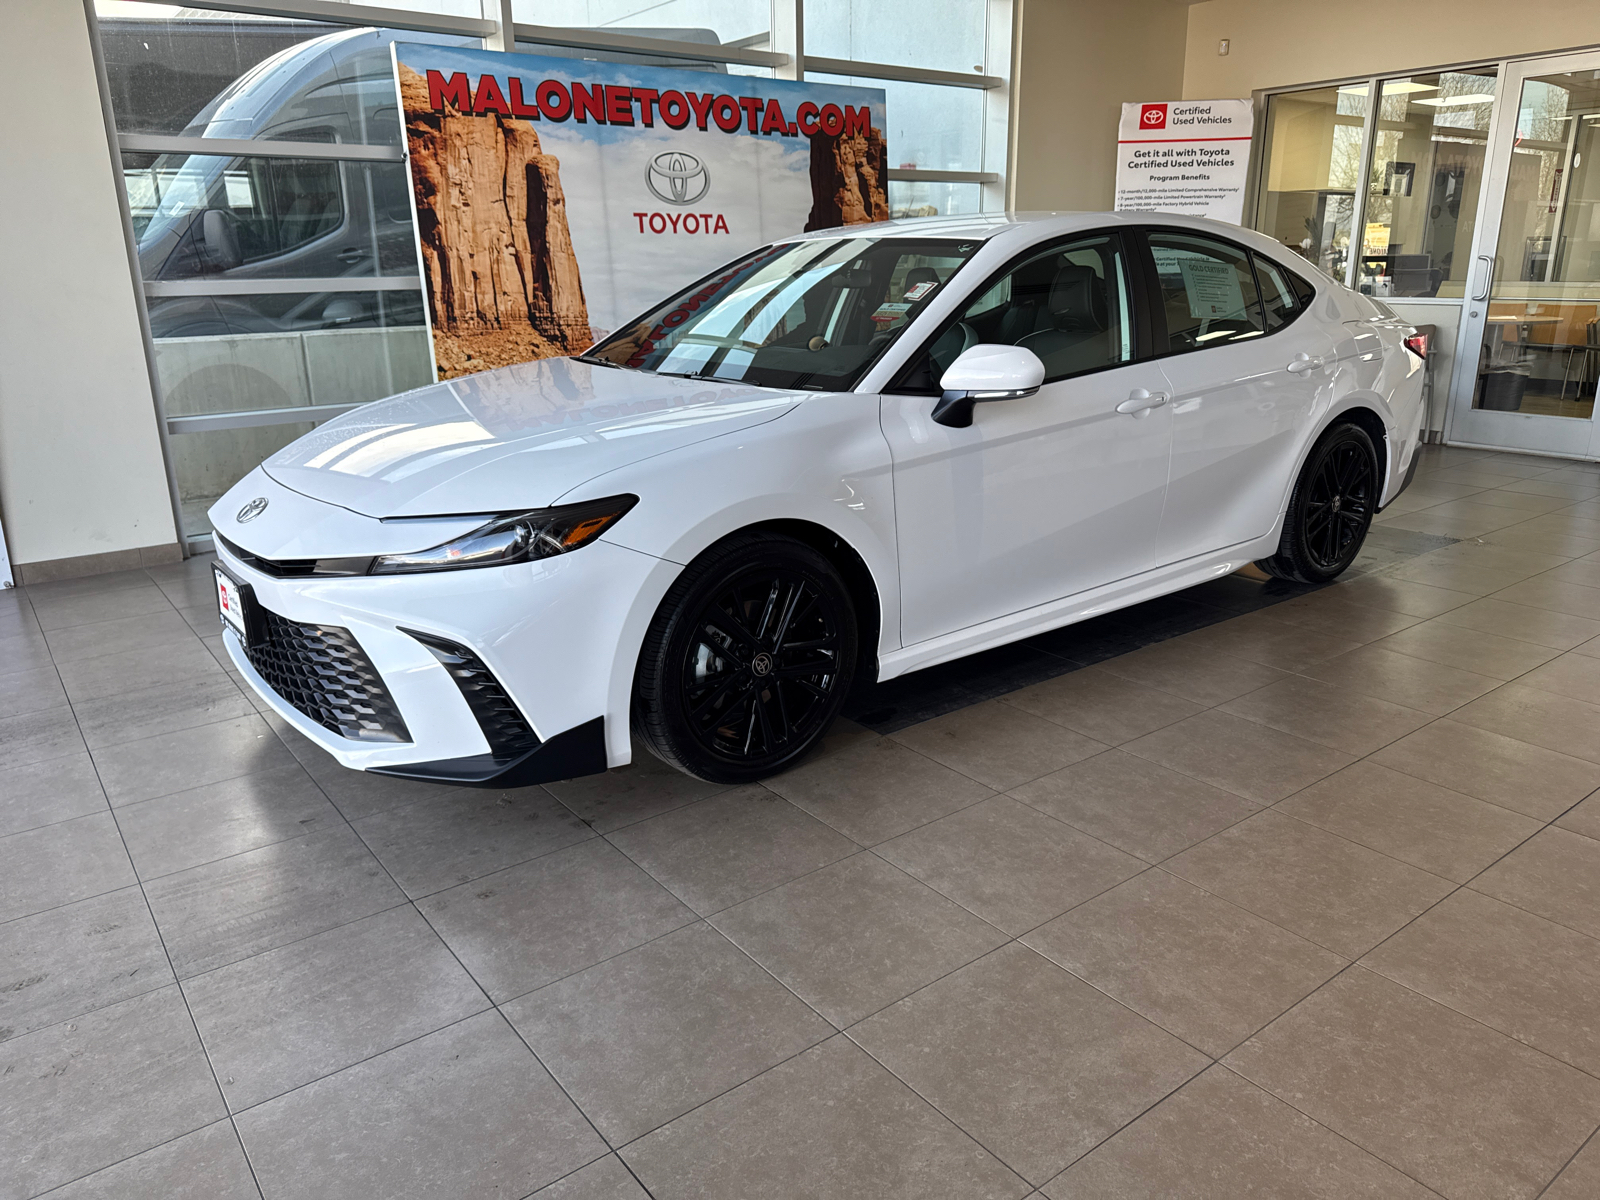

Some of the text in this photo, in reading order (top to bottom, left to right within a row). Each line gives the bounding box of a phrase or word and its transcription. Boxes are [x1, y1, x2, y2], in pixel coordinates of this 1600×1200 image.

[426, 68, 873, 140] MALONETOYOTA.COM
[1173, 106, 1211, 115] Certified
[1172, 115, 1232, 125] Used Vehicles
[1134, 150, 1151, 158] Get
[1161, 149, 1174, 157] all
[1175, 149, 1197, 157] with
[1199, 148, 1230, 159] Toyota
[1127, 158, 1235, 169] Certified Used Vehicles
[1149, 175, 1180, 183] Program
[633, 212, 730, 235] TOYOTA
[1188, 264, 1230, 275] GOLD CERTIFIED
